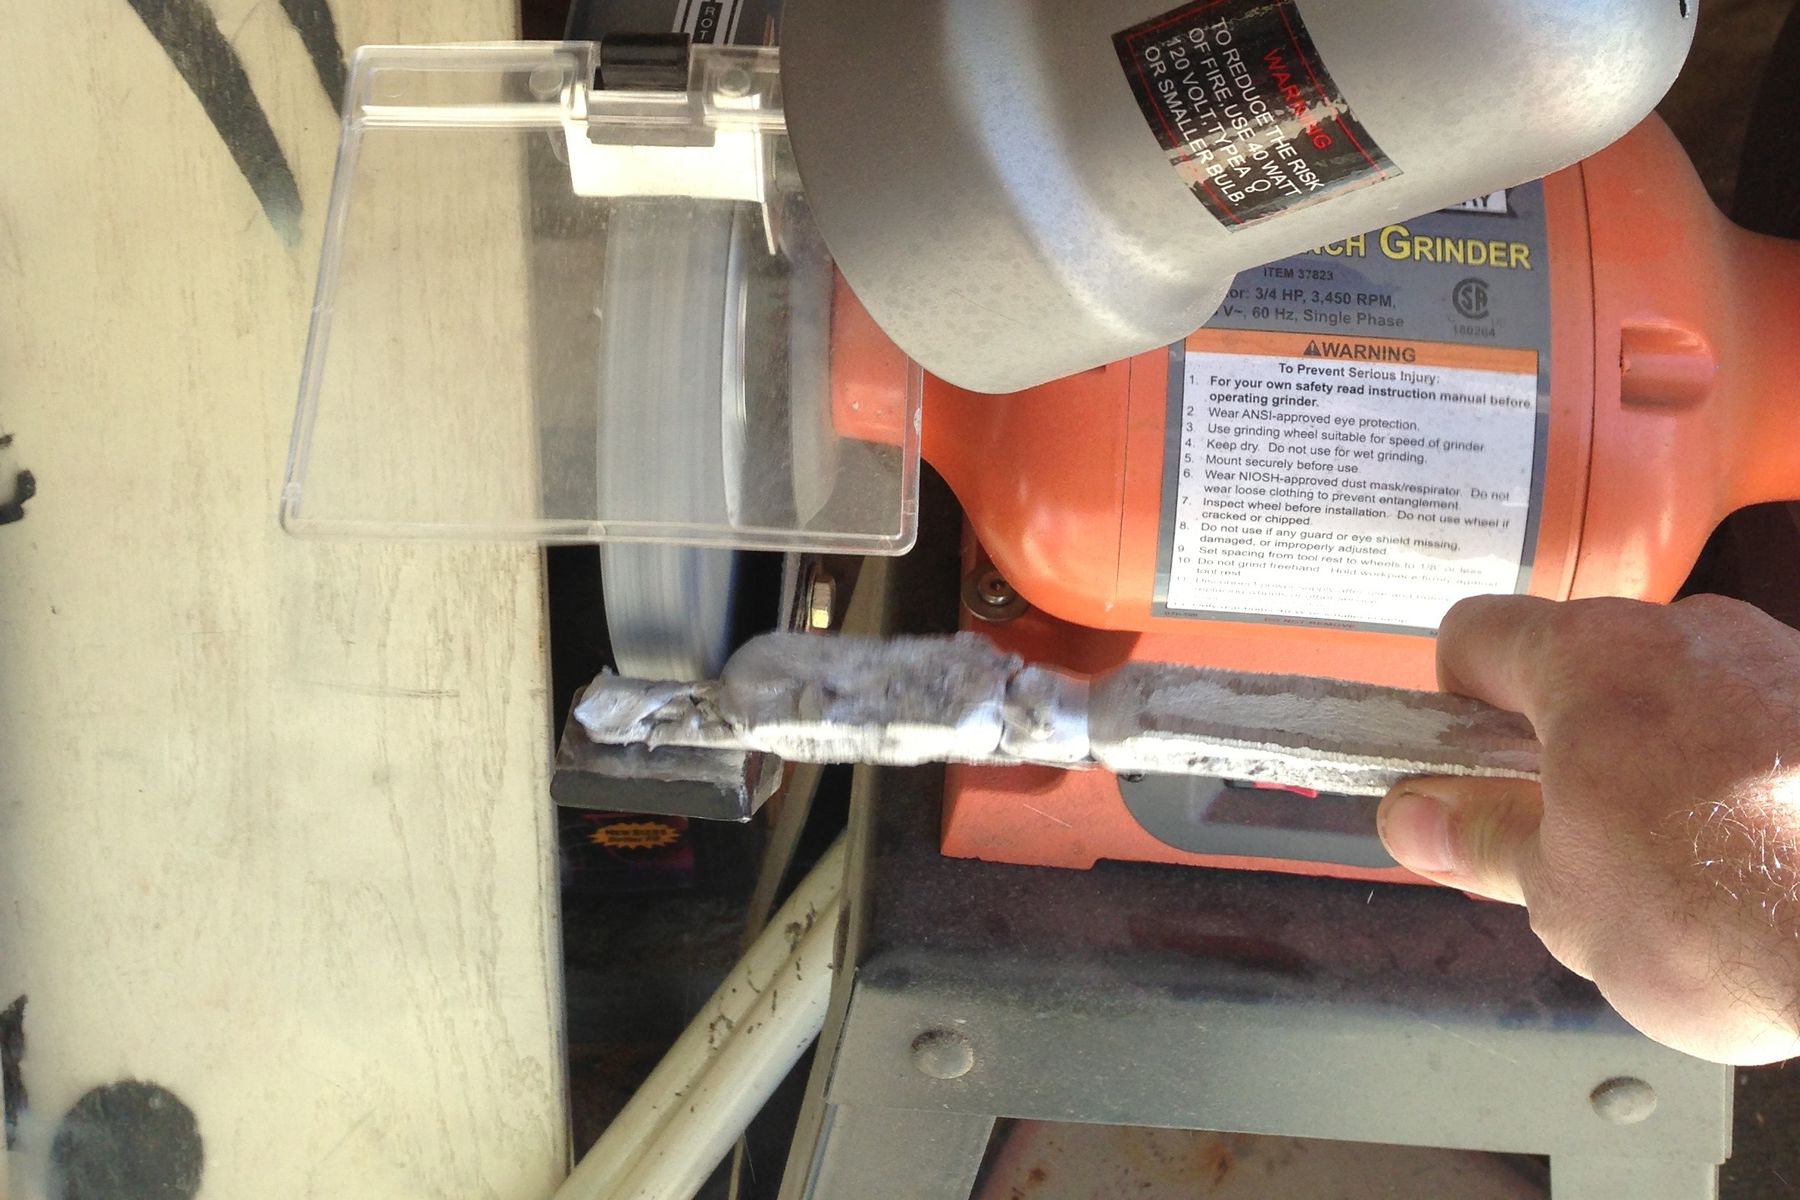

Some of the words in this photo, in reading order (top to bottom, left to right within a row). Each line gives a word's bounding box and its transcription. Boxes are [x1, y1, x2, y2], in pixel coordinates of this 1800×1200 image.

[1165, 36, 1190, 71] 120
[1211, 16, 1232, 47] TO
[1222, 48, 1274, 127] REDUCE
[1265, 125, 1298, 162] THE
[1287, 158, 1325, 191] RISK
[1264, 47, 1333, 151] WARNING
[1189, 27, 1211, 53] OF
[1224, 103, 1256, 141] USE
[1248, 142, 1268, 161] 40
[1261, 161, 1302, 197] WATT
[1144, 46, 1167, 77] OR
[1157, 79, 1215, 165] SMALLER
[1206, 164, 1246, 207] BULB.
[1379, 223, 1533, 270] GRINDER
[1264, 267, 1294, 279] ITEM
[1298, 269, 1334, 281] 37823
[1226, 289, 1250, 300] or:
[1255, 288, 1278, 300] 3/4
[1282, 290, 1307, 304] HP,
[1311, 291, 1352, 306] 3,450
[1252, 307, 1270, 319] 60
[1275, 308, 1299, 322] Hz,
[1303, 309, 1351, 326] Single
[1357, 313, 1405, 327] Phase
[1321, 341, 1417, 362] WARNING
[1279, 363, 1294, 374] To
[1297, 364, 1345, 377] Prevent
[1348, 367, 1397, 381] Serious
[1400, 371, 1440, 385] Injury:
[1209, 392, 1269, 407] operating
[1272, 395, 1320, 408] grinder.
[1210, 376, 1231, 387] For
[1234, 379, 1263, 390] your
[1266, 381, 1292, 390] own
[1295, 380, 1333, 395] safety
[1336, 383, 1365, 395] read
[1368, 385, 1436, 400] instruction
[1440, 393, 1487, 405] manual
[1490, 394, 1531, 409] before
[1208, 407, 1239, 419] Wear
[1242, 410, 1331, 425] ANSI-approved
[1334, 414, 1355, 426] eye
[1359, 417, 1420, 431] protection.
[1208, 424, 1231, 435] Use
[1234, 425, 1281, 440] grinding
[1284, 427, 1318, 440] wheel
[1321, 430, 1366, 443] suitable
[1370, 433, 1385, 445] for
[1389, 435, 1425, 448] speed
[1428, 437, 1441, 448] of
[1206, 439, 1237, 453] Keep
[1269, 442, 1285, 453] Do
[1288, 444, 1307, 455] not
[1310, 447, 1331, 457] use
[1334, 445, 1352, 457] for
[1353, 449, 1374, 459] wet
[1377, 450, 1427, 465] grinding.
[1206, 454, 1242, 466] Mount
[1245, 456, 1294, 470] securely
[1297, 461, 1334, 472] before
[1203, 486, 1233, 495] wear
[1235, 485, 1266, 496] loose
[1269, 487, 1314, 501] clothing
[1317, 490, 1329, 500] to
[1332, 492, 1376, 504] prevent
[1205, 470, 1236, 481] Wear
[1239, 471, 1338, 487] NIOSH-approved
[1341, 478, 1366, 489] dust
[1471, 487, 1488, 499] Do
[1491, 490, 1510, 501] not
[1201, 510, 1247, 522] cracked
[1250, 514, 1261, 522] or
[1265, 515, 1313, 528] chipped.
[1203, 497, 1245, 510] Inspect
[1248, 499, 1282, 511] wheel
[1285, 502, 1322, 513] before
[1397, 510, 1415, 521] Do
[1417, 512, 1436, 523] not
[1439, 516, 1461, 525] use
[1464, 517, 1499, 528] wheel
[1502, 520, 1510, 529] if
[1199, 535, 1256, 547] damaged,
[1259, 539, 1271, 547] or
[1275, 539, 1335, 552] improperly
[1200, 522, 1217, 532] Do
[1220, 524, 1238, 533] not
[1241, 527, 1263, 535] use
[1266, 526, 1273, 535] if
[1275, 528, 1297, 539] any
[1299, 530, 1333, 541] guard
[1336, 533, 1349, 541] or
[1351, 535, 1372, 544] eye
[1375, 535, 1410, 546] shield
[1198, 557, 1214, 565] Do
[1217, 559, 1236, 567] not
[1238, 560, 1267, 569] grind
[1199, 546, 1220, 555] Set
[1221, 548, 1265, 559] spacing
[1268, 551, 1294, 560] from
[1297, 552, 1318, 562] tool
[1321, 555, 1343, 564] rest
[1346, 557, 1357, 565] to
[1360, 558, 1400, 568] wheels
[1196, 568, 1217, 576] tool
[1220, 569, 1241, 577] rest
